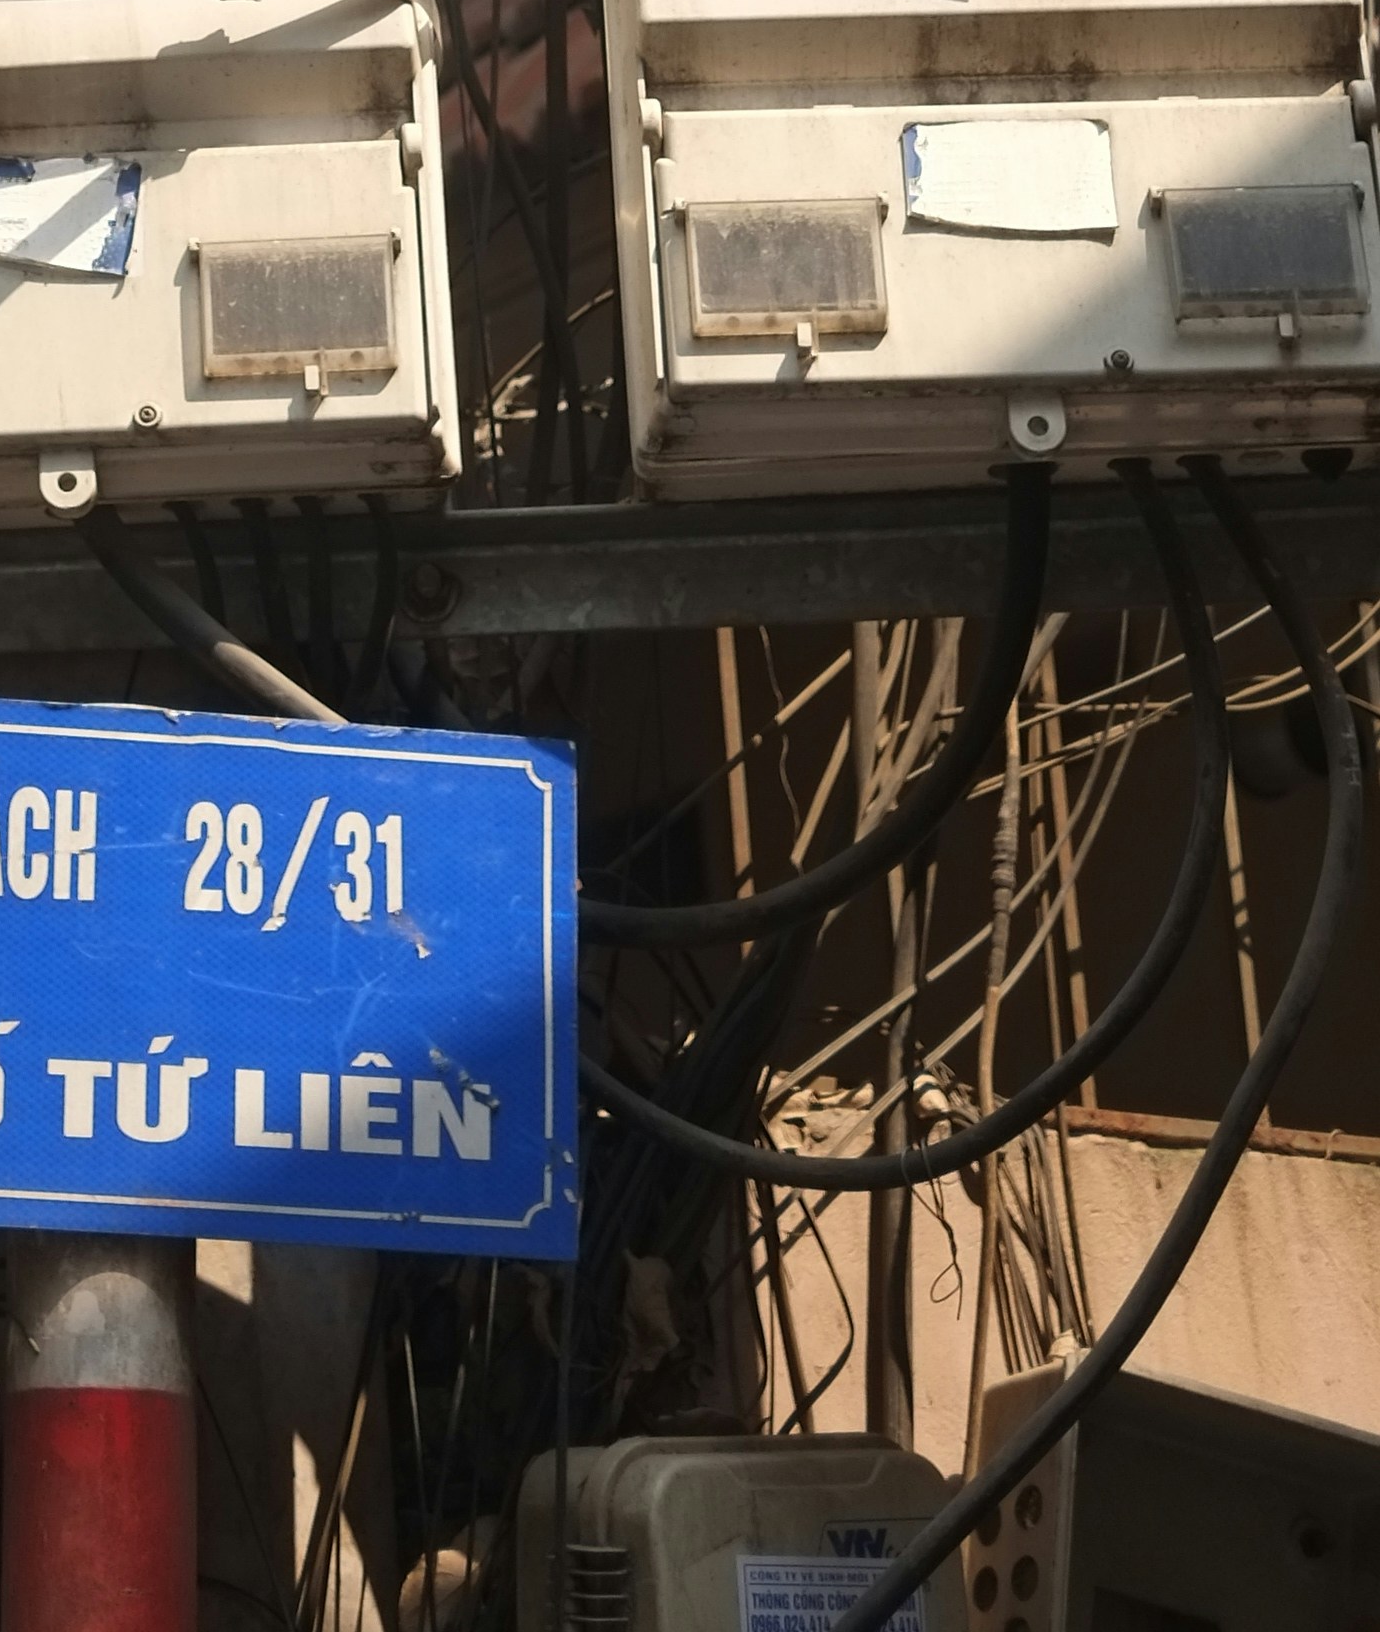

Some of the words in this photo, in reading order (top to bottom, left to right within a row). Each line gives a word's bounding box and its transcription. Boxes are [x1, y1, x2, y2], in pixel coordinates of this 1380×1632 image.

[183, 796, 404, 931] 28/31
[47, 1035, 208, 1144] TỨ
[234, 1051, 492, 1161] LIÊN
